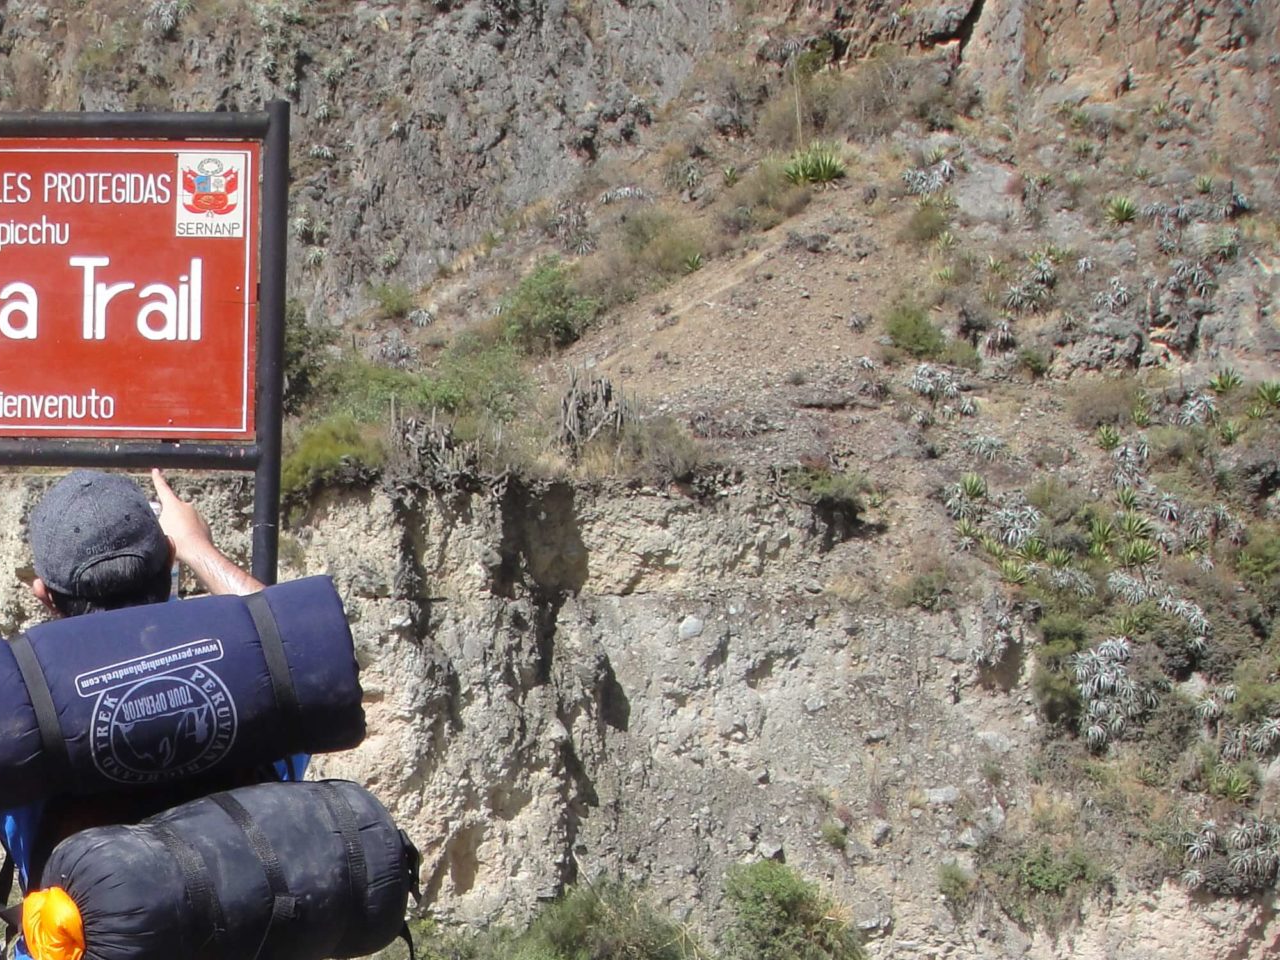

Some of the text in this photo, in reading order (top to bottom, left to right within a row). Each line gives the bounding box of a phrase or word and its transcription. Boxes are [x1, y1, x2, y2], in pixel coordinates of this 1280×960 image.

[44, 173, 170, 203] PROTEGIDAS
[177, 222, 241, 236] SERNANP
[69, 256, 202, 340] Trail
[80, 643, 219, 689] www.peruvianhighlandtrek.com
[96, 694, 119, 751] TREK
[122, 685, 193, 721] TOUR OPERATOR
[189, 669, 233, 761] PERUVIAN
